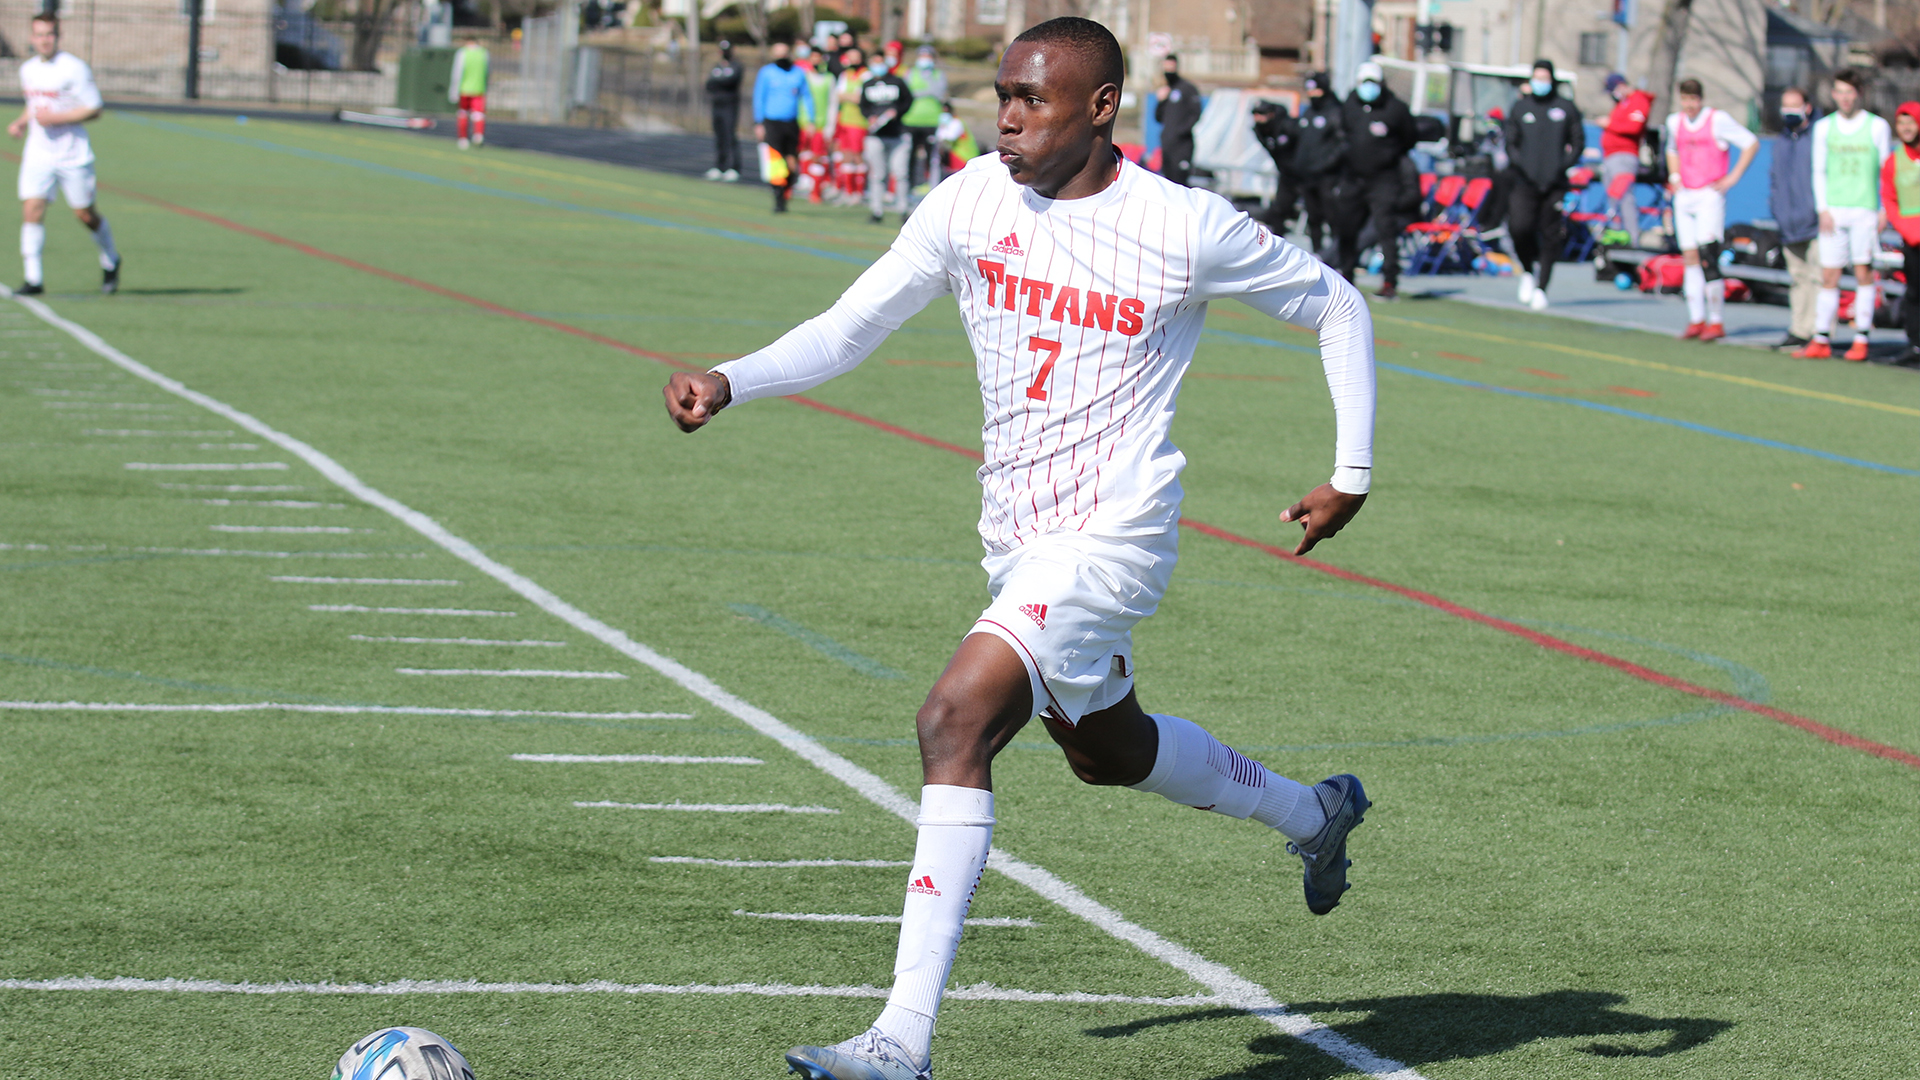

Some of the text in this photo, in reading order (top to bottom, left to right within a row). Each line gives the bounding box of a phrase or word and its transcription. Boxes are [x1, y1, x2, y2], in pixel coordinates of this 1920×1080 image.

[992, 244, 1025, 257] adidas
[976, 258, 1146, 337] TITANS
[1025, 336, 1062, 402] 7
[1018, 604, 1047, 631] adidas
[907, 886, 942, 897] adidas
